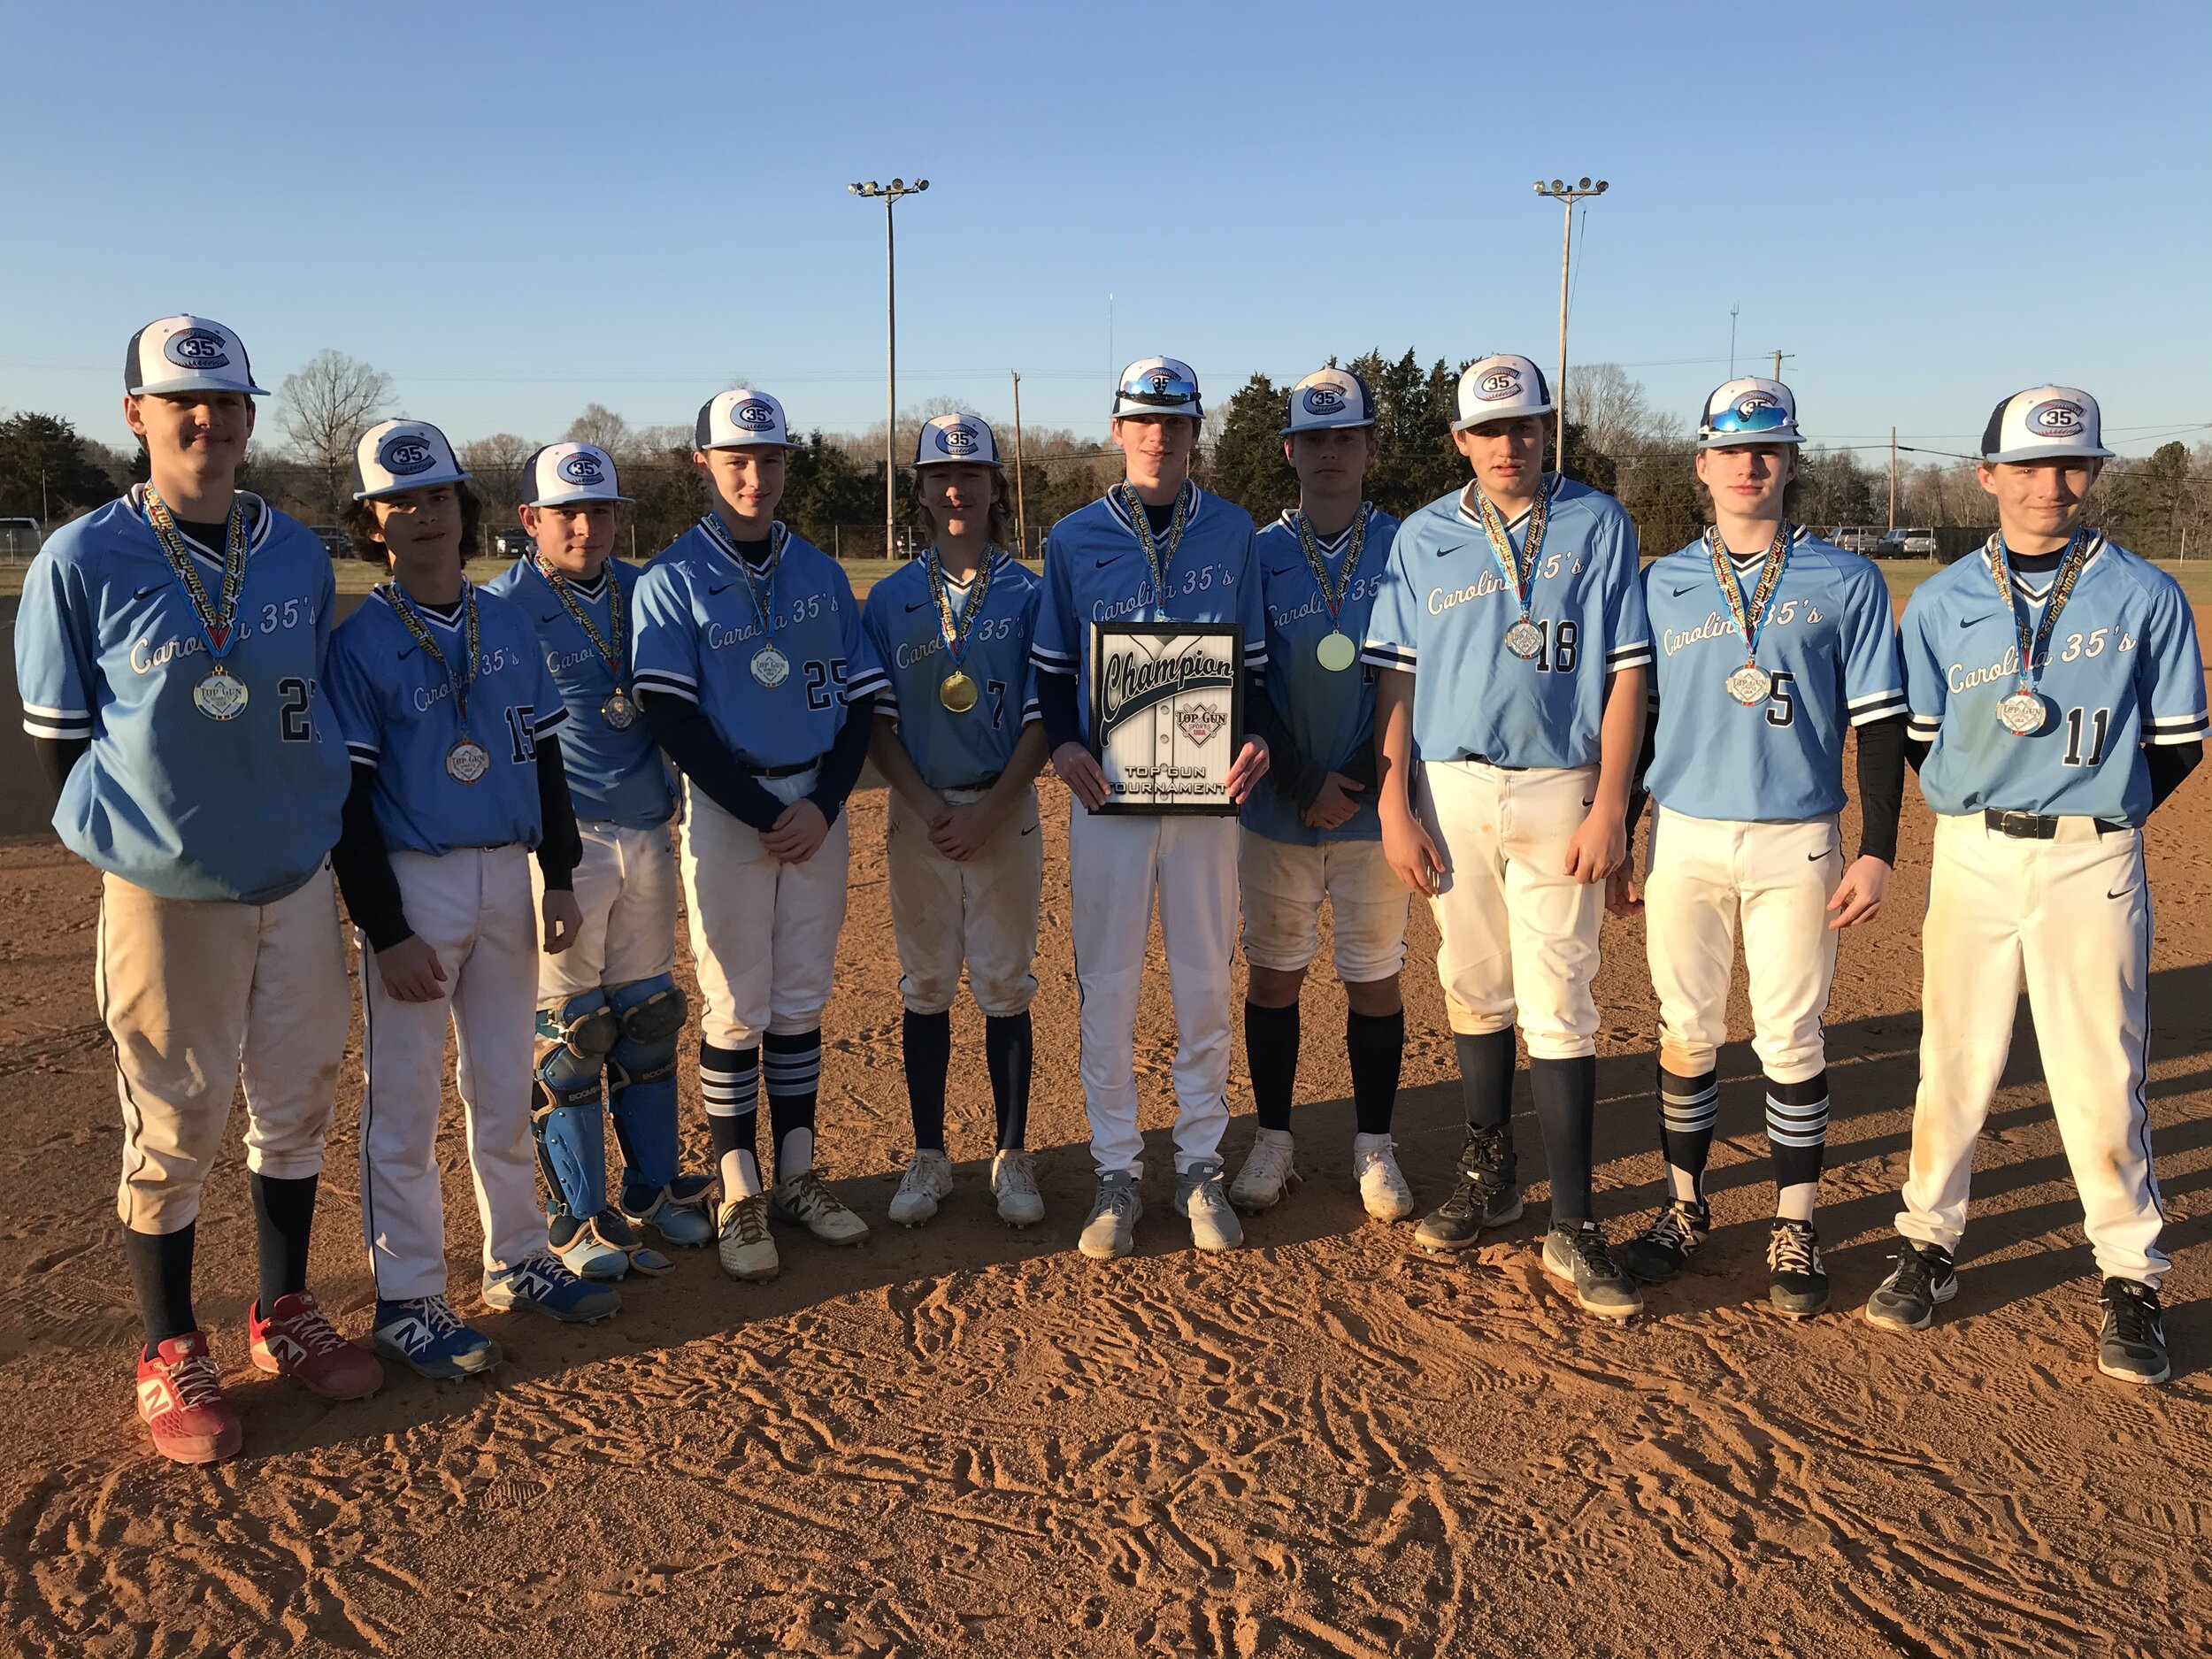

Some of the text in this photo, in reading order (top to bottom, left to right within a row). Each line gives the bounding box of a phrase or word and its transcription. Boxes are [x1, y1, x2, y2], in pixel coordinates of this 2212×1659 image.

[184, 340, 216, 356] 35
[1488, 376, 1509, 390] 35
[1315, 392, 1335, 404] 35
[746, 408, 767, 421] 35
[2046, 411, 2072, 426] 35
[949, 433, 970, 445] 35
[396, 446, 423, 463] 35
[573, 462, 595, 474] 35
[1131, 499, 1143, 515] TOP
[1136, 517, 1150, 535] GUN
[1486, 515, 1502, 533] GUN
[1526, 518, 1538, 540] GUN
[1304, 534, 1317, 550] GUN
[1345, 541, 1356, 558] GUN
[1523, 539, 1533, 558] TOP
[154, 507, 173, 530] TOP
[165, 531, 187, 556] GUN
[177, 555, 209, 602] SPORTS
[200, 603, 220, 626] USA
[225, 549, 238, 572] GUN
[1310, 551, 1330, 582] SPORTS
[1340, 558, 1351, 575] TOP
[1717, 556, 1732, 573] GUN
[2070, 551, 2085, 571] TOP
[1760, 562, 1774, 583] GUN
[2061, 569, 2078, 594] GUN
[221, 573, 235, 596] TOP
[1092, 563, 1235, 622] Carolia 35's
[1322, 582, 1335, 599] USA
[1333, 576, 1346, 598] PLAY
[1427, 570, 1509, 616] Carolin
[1723, 574, 1741, 607] SPORTS
[1754, 581, 1767, 602] TOP
[793, 592, 839, 624] 35's
[964, 600, 975, 617] TOP
[970, 583, 980, 601] GUN
[393, 603, 424, 637] SPORTS
[560, 587, 580, 607] GUN
[572, 605, 603, 641] SPORTS
[2042, 592, 2069, 636] SPORTS
[978, 617, 1024, 641] 35's
[1663, 611, 1738, 657] Carolin
[1535, 618, 1578, 673] 18
[481, 647, 520, 676] 35's
[1947, 625, 2137, 694] Carolia 35's
[803, 657, 849, 711] 25
[1102, 649, 1234, 722] Champion
[987, 679, 1008, 730] 7
[1765, 670, 1795, 728] 5
[1176, 710, 1226, 724] TOP GUN
[504, 705, 538, 764] 15
[2062, 706, 2111, 768] 11
[1125, 766, 1207, 779] TOP GUN
[513, 1275, 549, 1302] N
[394, 1321, 431, 1354] N
[271, 1339, 304, 1368] N
